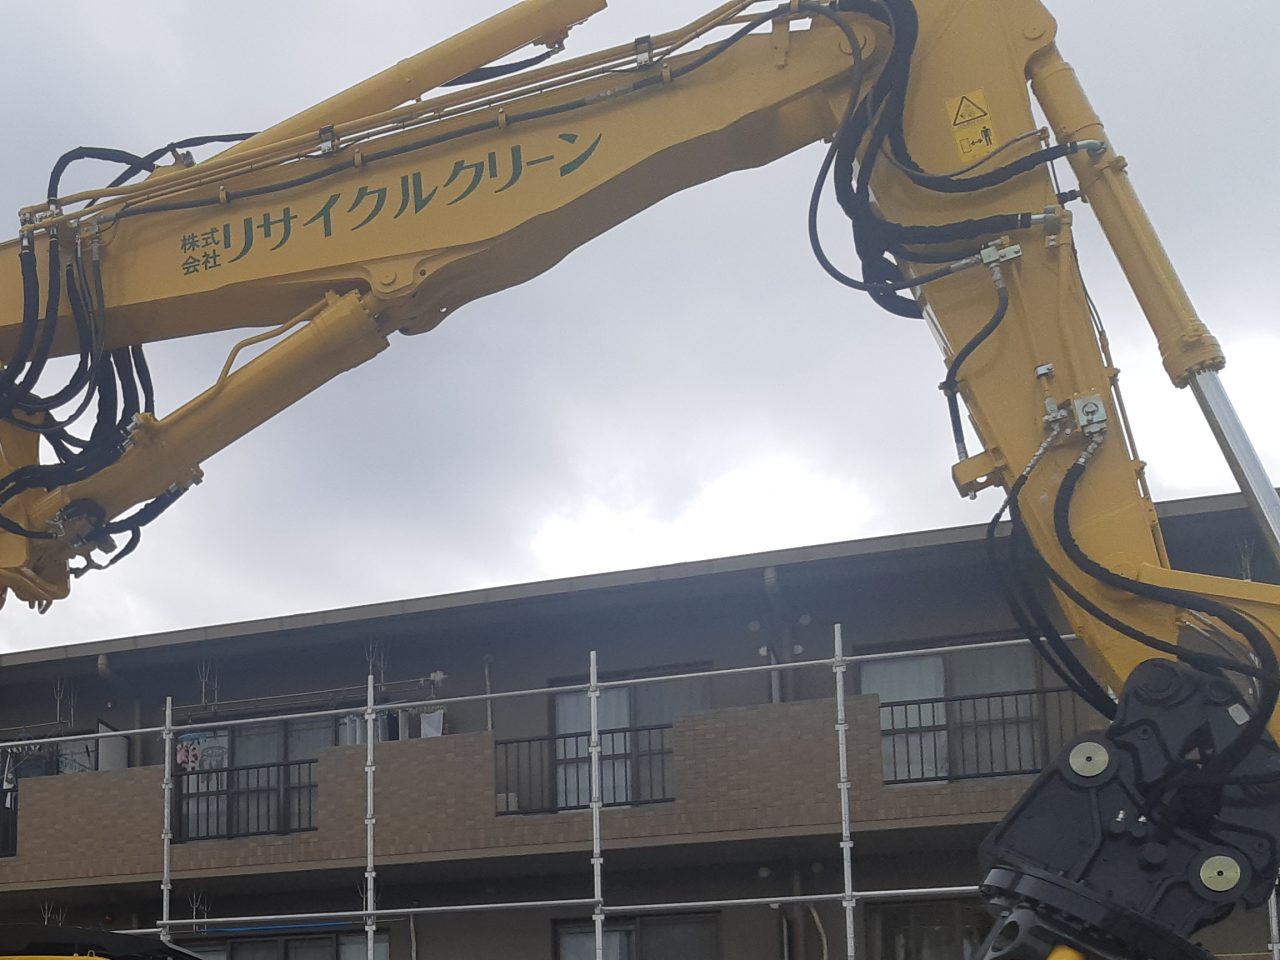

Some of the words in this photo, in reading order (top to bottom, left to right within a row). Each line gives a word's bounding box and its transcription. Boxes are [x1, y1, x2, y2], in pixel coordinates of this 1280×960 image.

[223, 132, 603, 264] リサイクルクリーン
[181, 227, 220, 253] 株式
[181, 250, 222, 275] 会社
